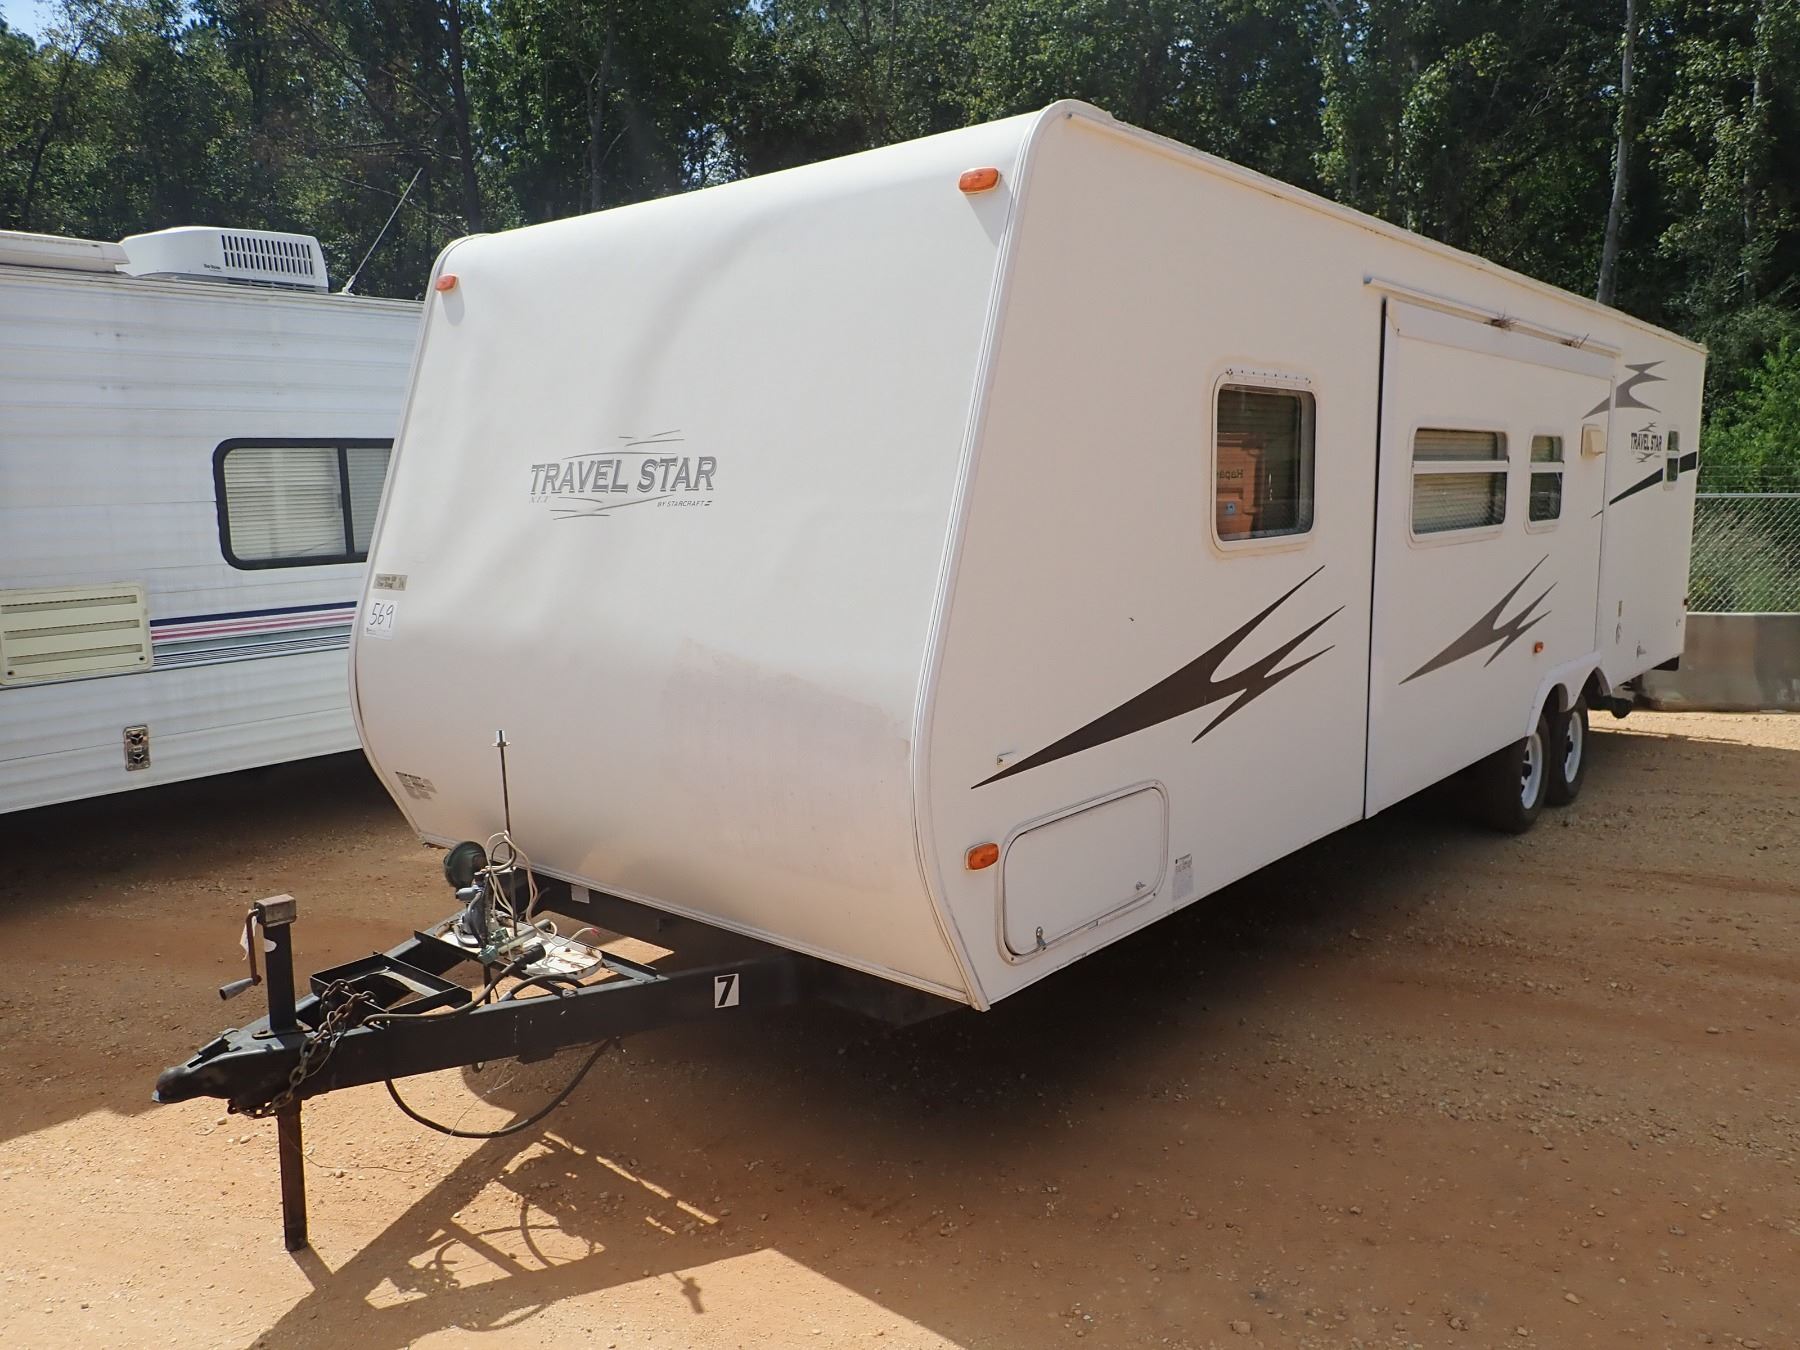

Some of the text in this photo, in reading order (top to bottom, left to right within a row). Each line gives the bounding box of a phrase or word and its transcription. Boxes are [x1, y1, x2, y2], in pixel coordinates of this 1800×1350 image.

[1631, 432, 1662, 451] TRAVEL STAR
[530, 456, 717, 495] TRAVEL STAR
[369, 602, 394, 629] 569
[717, 974, 737, 1007] 7
